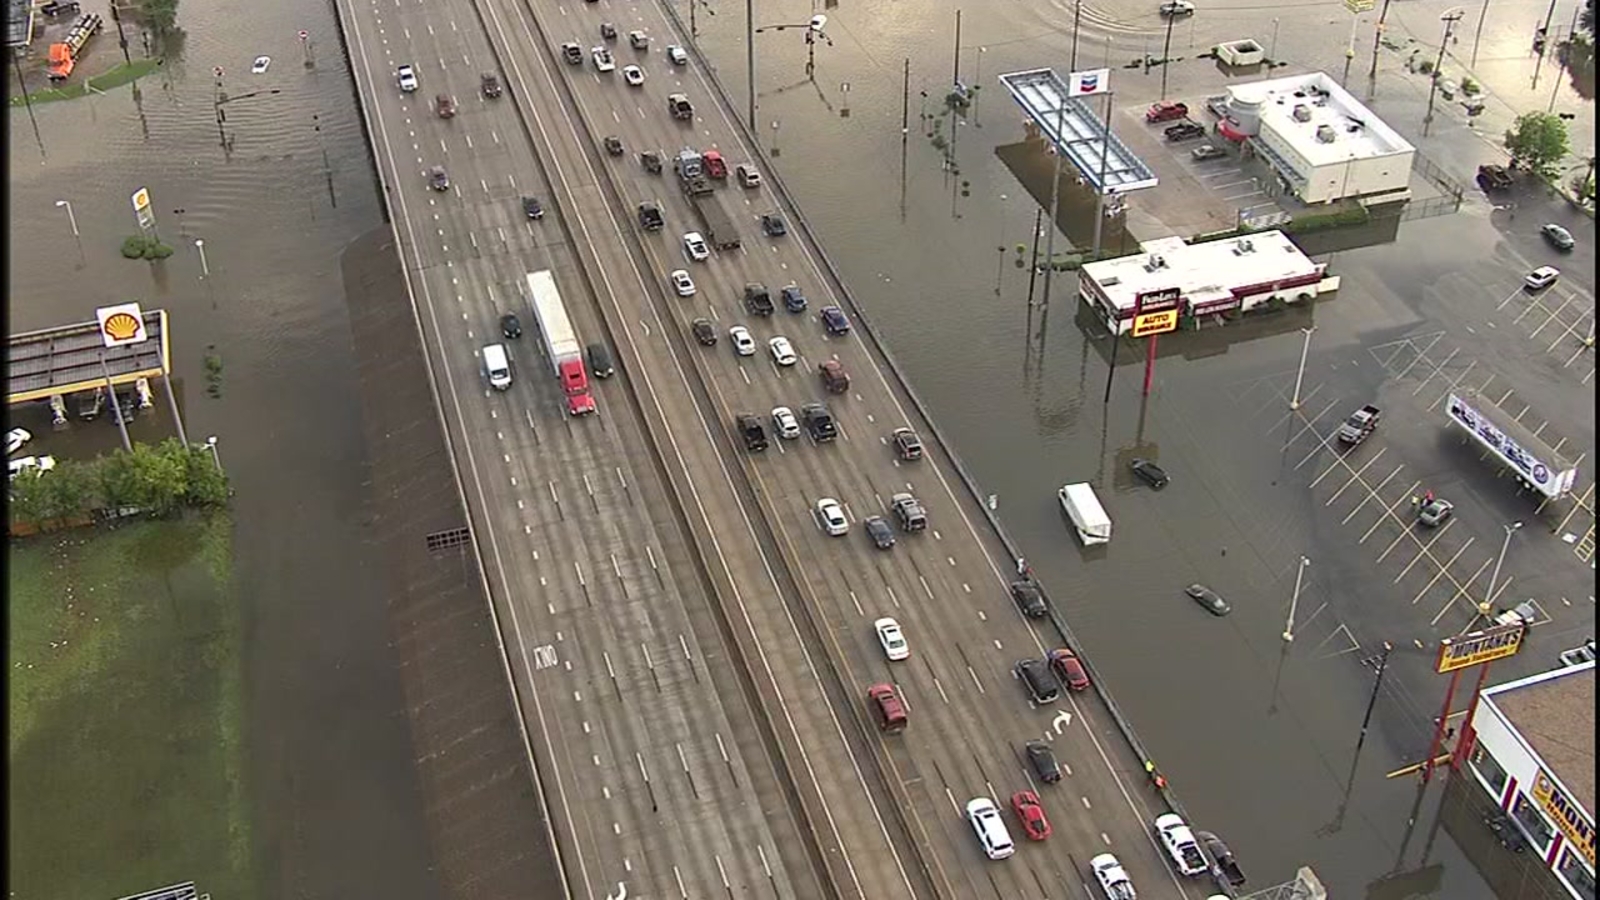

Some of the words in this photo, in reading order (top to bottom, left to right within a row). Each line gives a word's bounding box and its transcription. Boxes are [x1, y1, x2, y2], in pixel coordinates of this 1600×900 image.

[1142, 313, 1170, 325] AUTO
[533, 644, 559, 670] ONLY
[1449, 628, 1521, 660] MONTANA'S
